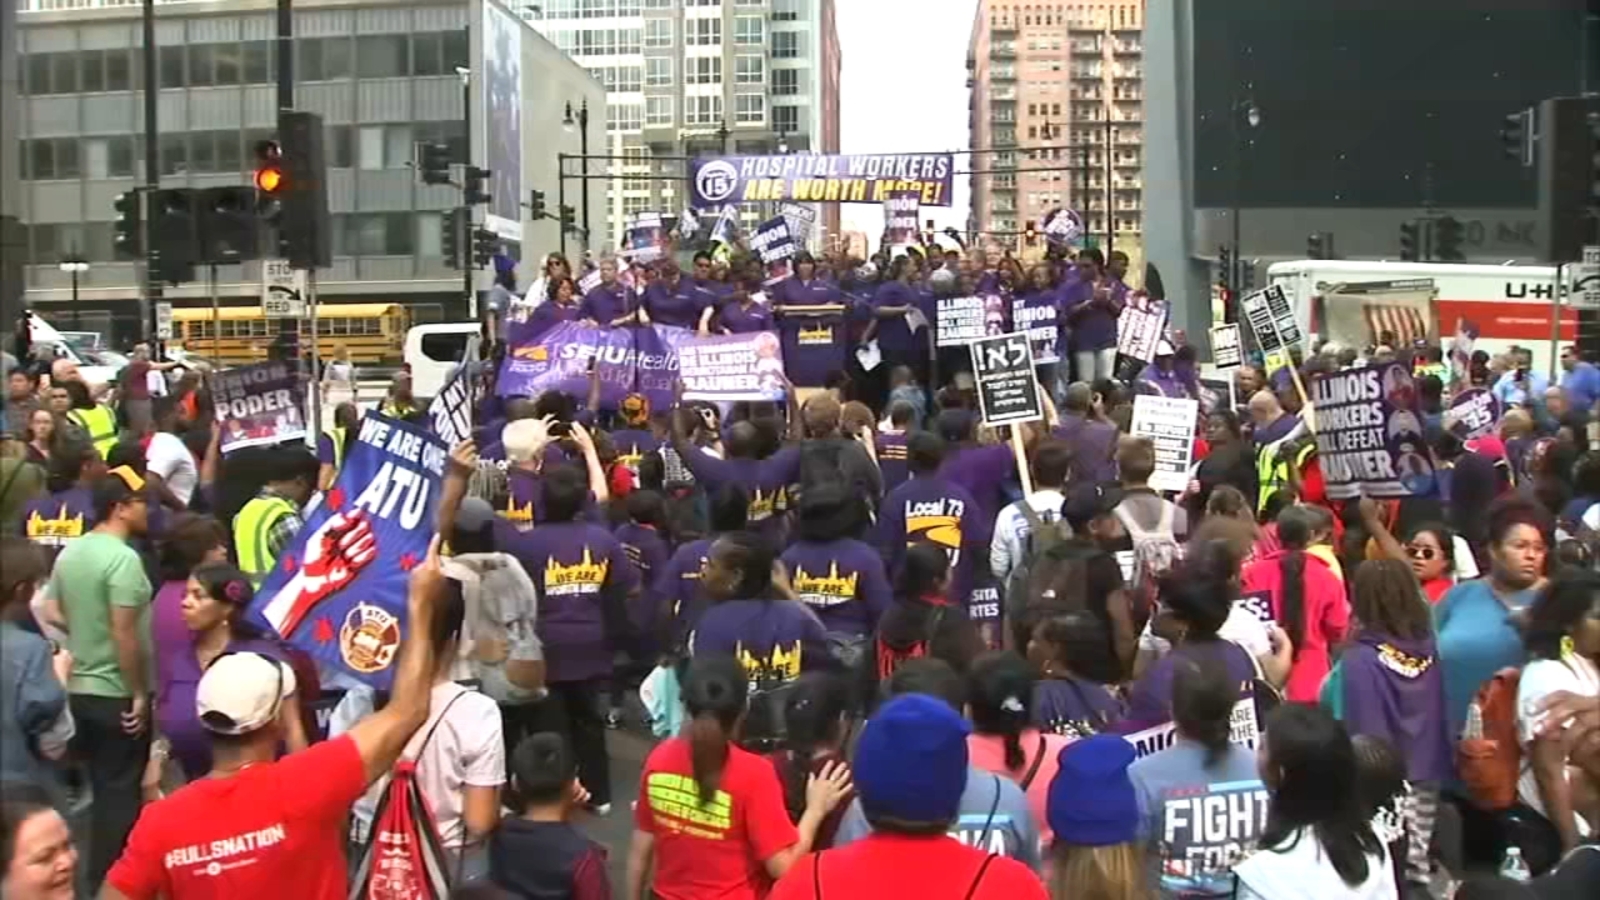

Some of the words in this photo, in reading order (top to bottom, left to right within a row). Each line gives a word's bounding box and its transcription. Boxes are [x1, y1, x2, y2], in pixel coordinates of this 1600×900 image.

[741, 155, 839, 178] HOSPITAL
[848, 155, 948, 179] WORKERS
[742, 178, 787, 201] ARE
[791, 179, 867, 201] WORTH
[267, 264, 291, 275] STO
[560, 342, 626, 364] SEIU
[975, 338, 1027, 371] לא!
[214, 389, 293, 422] PODER
[358, 417, 391, 449] WE
[385, 429, 423, 463] ARE
[353, 461, 430, 530] ATU
[905, 497, 946, 517] Local
[947, 499, 964, 517] 73
[1164, 789, 1270, 844] FIGHT
